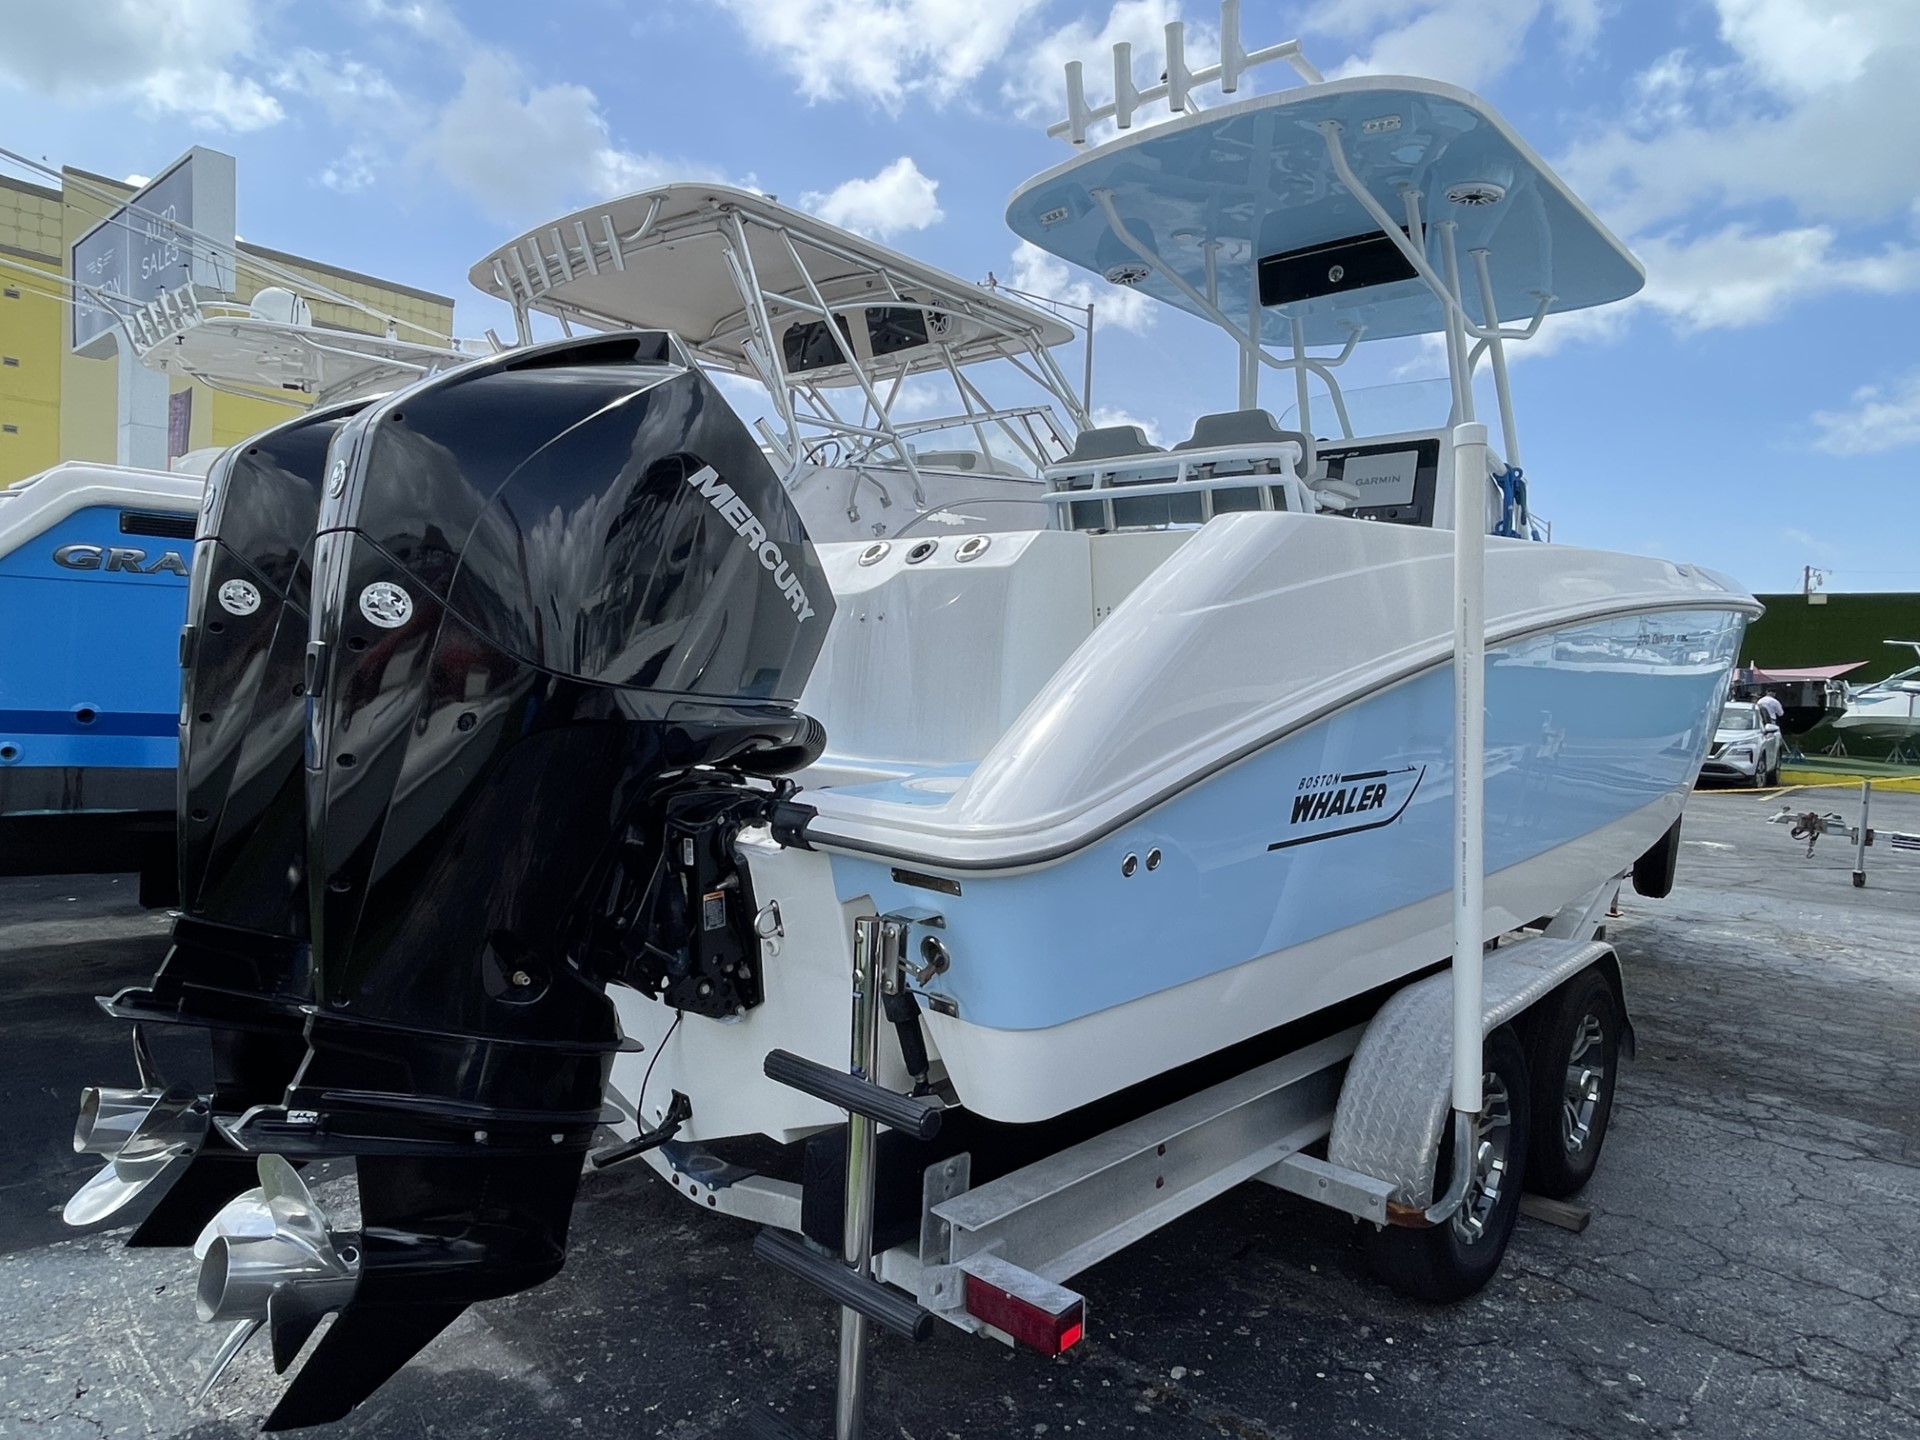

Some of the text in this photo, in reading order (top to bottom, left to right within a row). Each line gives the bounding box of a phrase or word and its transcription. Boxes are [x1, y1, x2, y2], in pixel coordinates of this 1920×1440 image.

[144, 203, 177, 245] AUTO
[141, 237, 180, 280] SALES
[1355, 475, 1401, 487] GARMIN
[687, 464, 816, 623] MERCURY
[1298, 772, 1341, 791] BOSTON
[1290, 783, 1388, 825] WHALER
